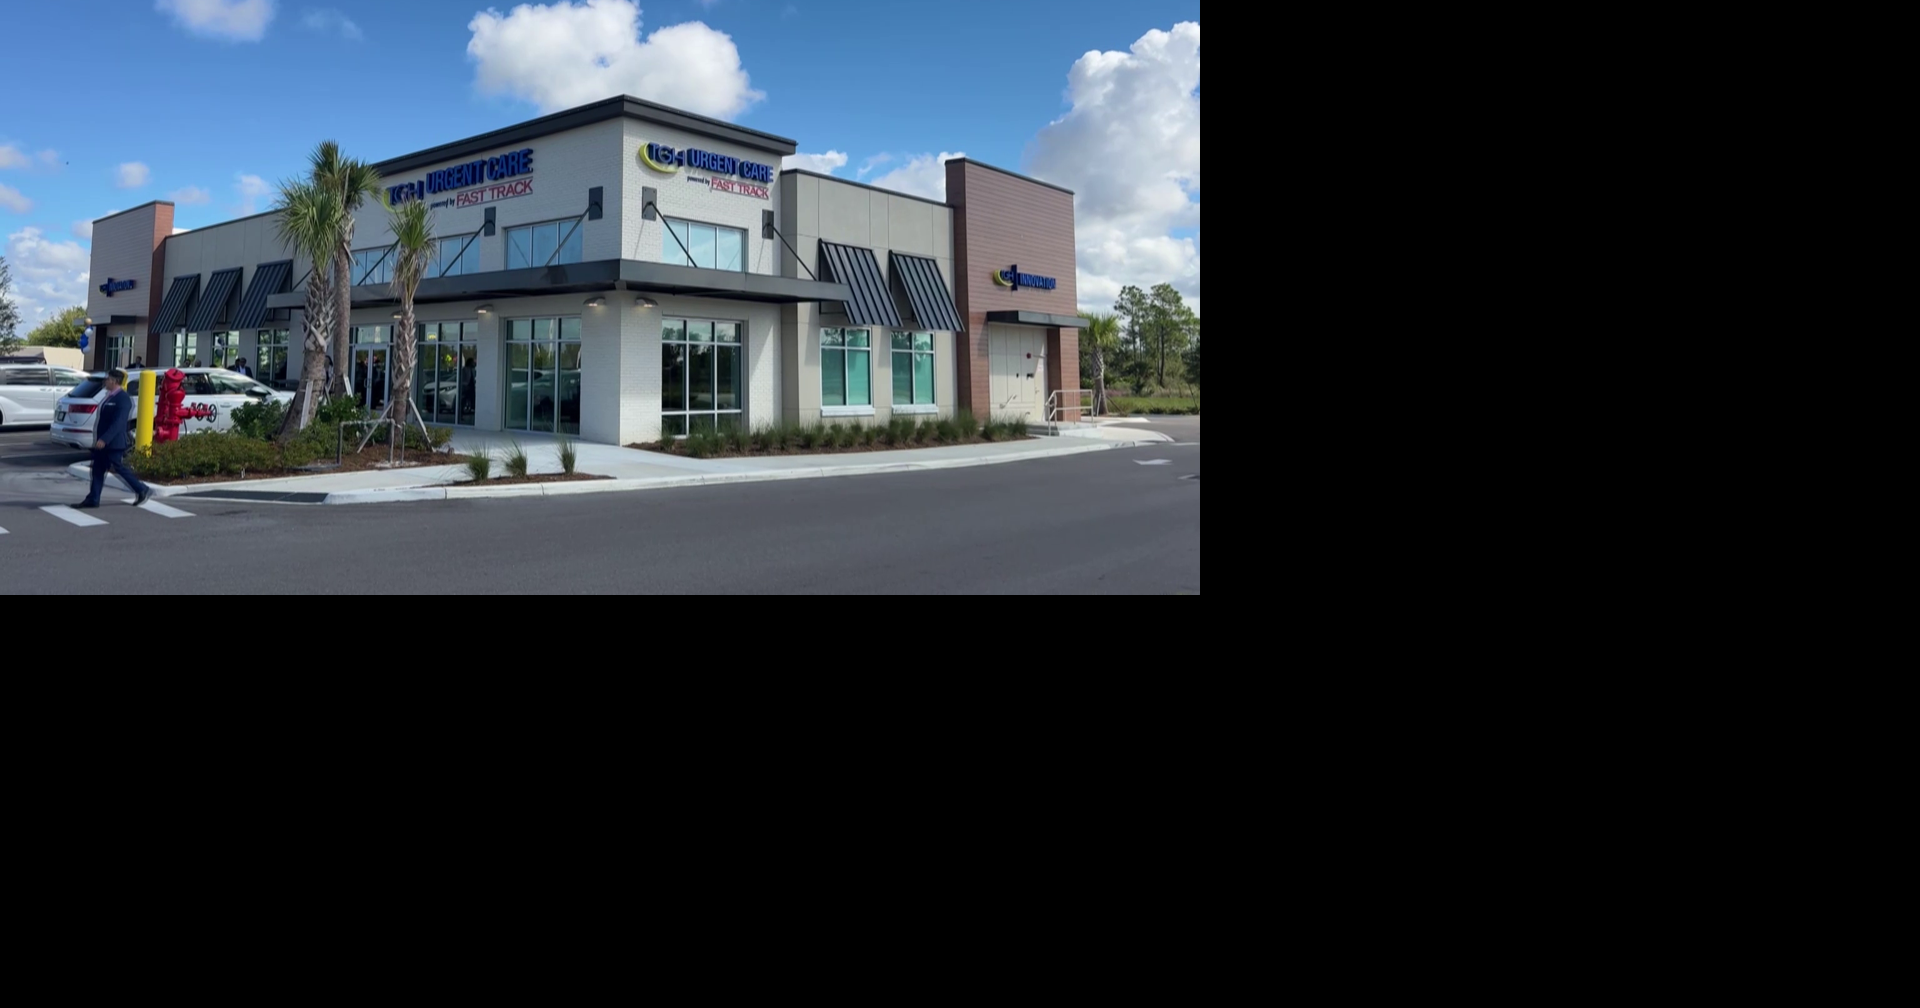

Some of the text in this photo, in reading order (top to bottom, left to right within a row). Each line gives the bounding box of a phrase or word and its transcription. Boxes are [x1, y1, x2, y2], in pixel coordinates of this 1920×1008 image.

[426, 159, 486, 194] URGENT
[486, 148, 533, 181] CARE
[647, 142, 774, 183] TGH URGENT CARE
[456, 189, 487, 206] FAST
[488, 179, 533, 199] TRACK
[711, 178, 736, 191] FAST
[737, 182, 769, 199] TRACK
[1018, 273, 1056, 290] INNOVATION
